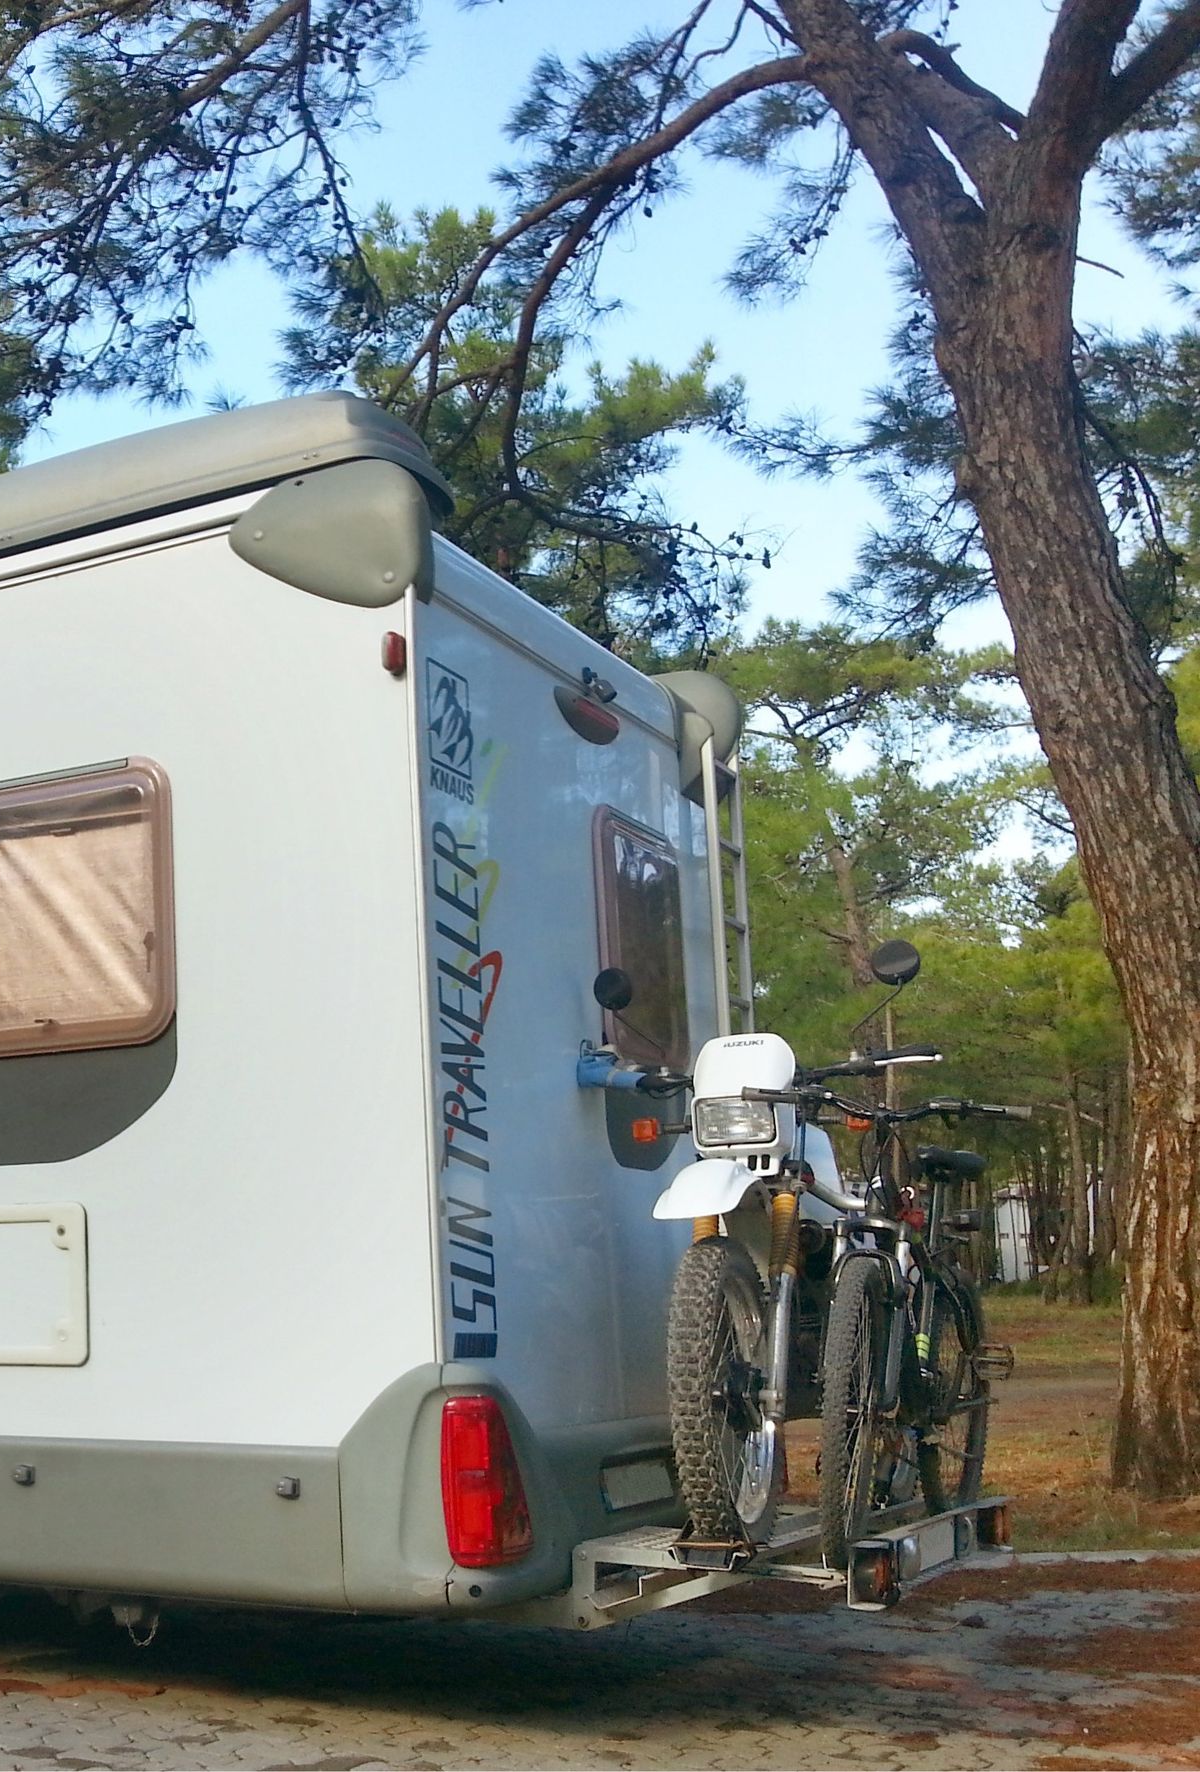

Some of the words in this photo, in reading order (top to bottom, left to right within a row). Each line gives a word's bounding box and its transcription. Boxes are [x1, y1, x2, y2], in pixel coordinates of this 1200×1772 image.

[430, 766, 474, 805] KNAUS
[432, 821, 490, 1173] TRAVELLER
[447, 1197, 498, 1332] SUN
